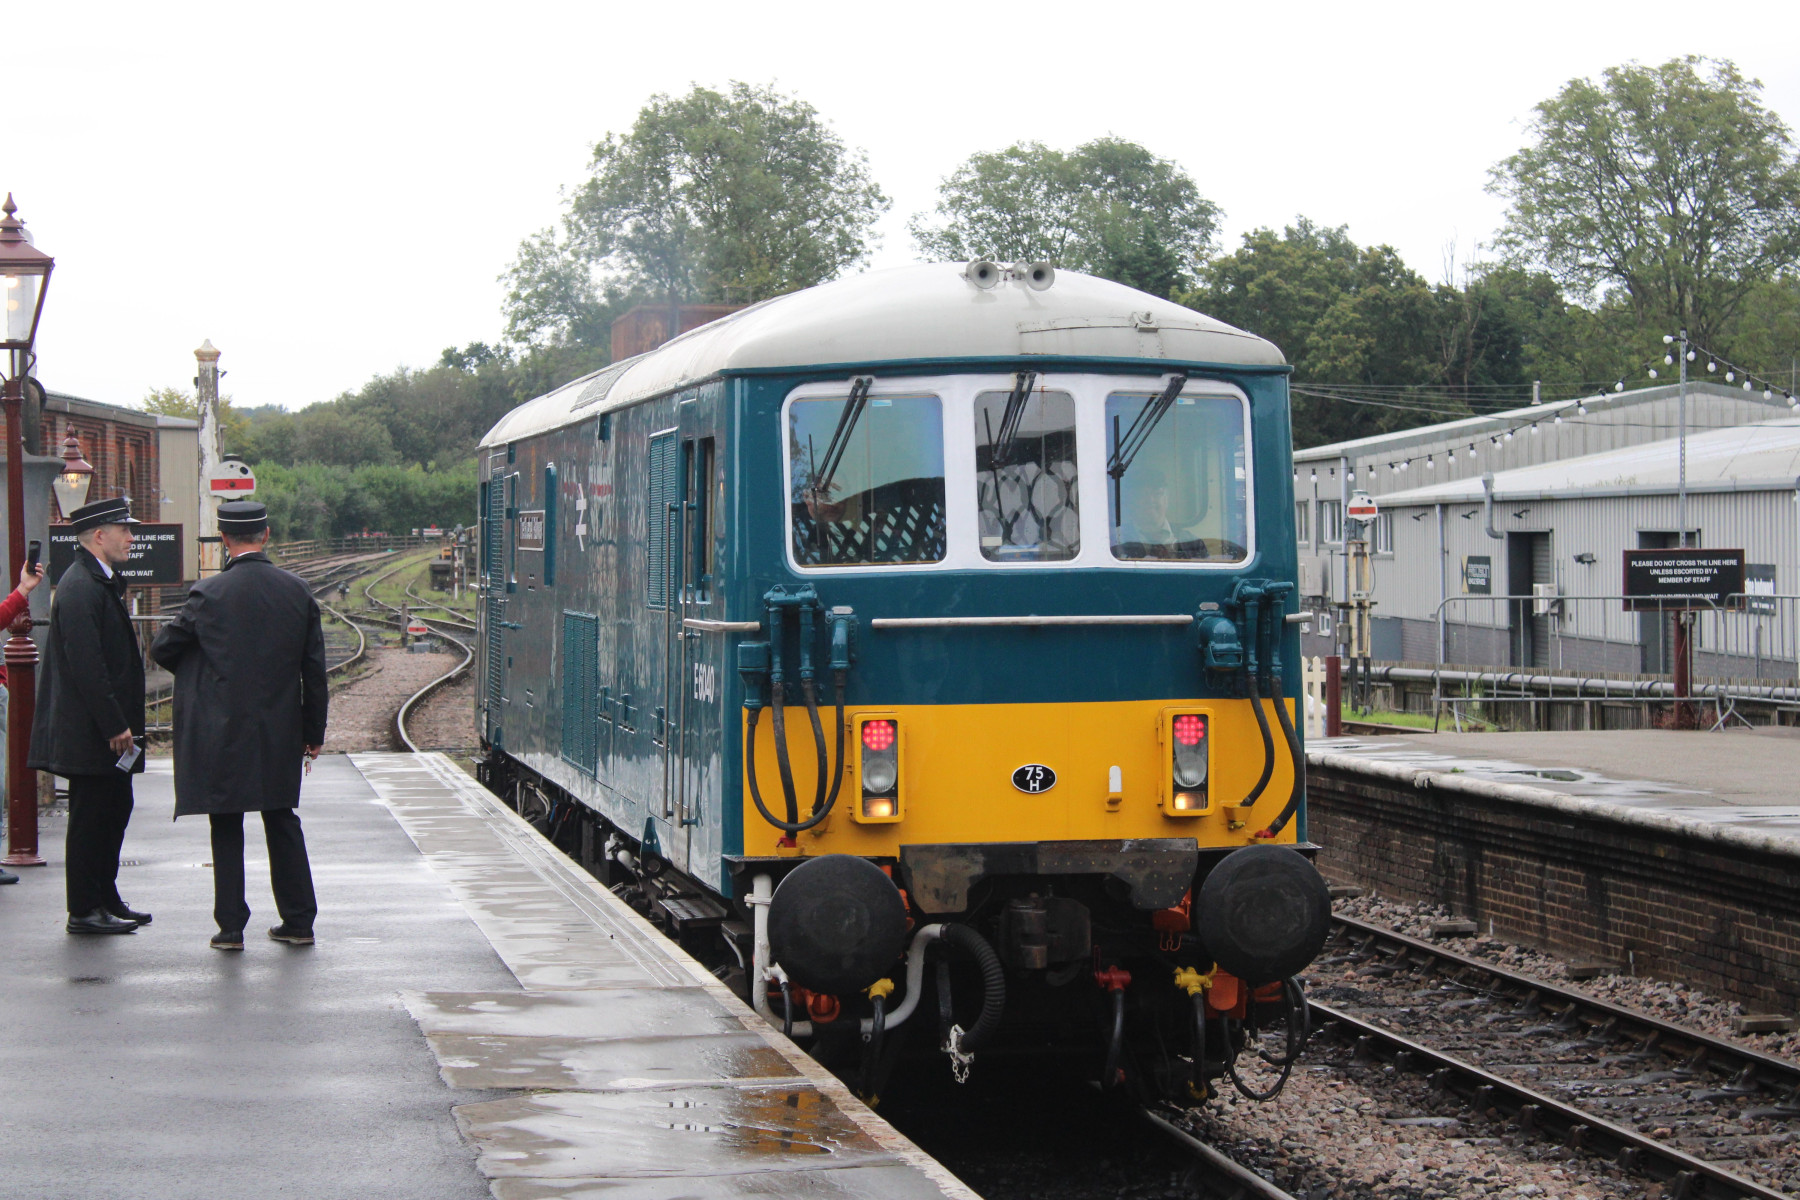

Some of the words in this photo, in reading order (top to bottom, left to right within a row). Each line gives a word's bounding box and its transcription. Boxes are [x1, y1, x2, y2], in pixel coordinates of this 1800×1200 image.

[694, 662, 715, 704] E6040
[1025, 766, 1044, 780] 75
[1029, 779, 1040, 791] H
